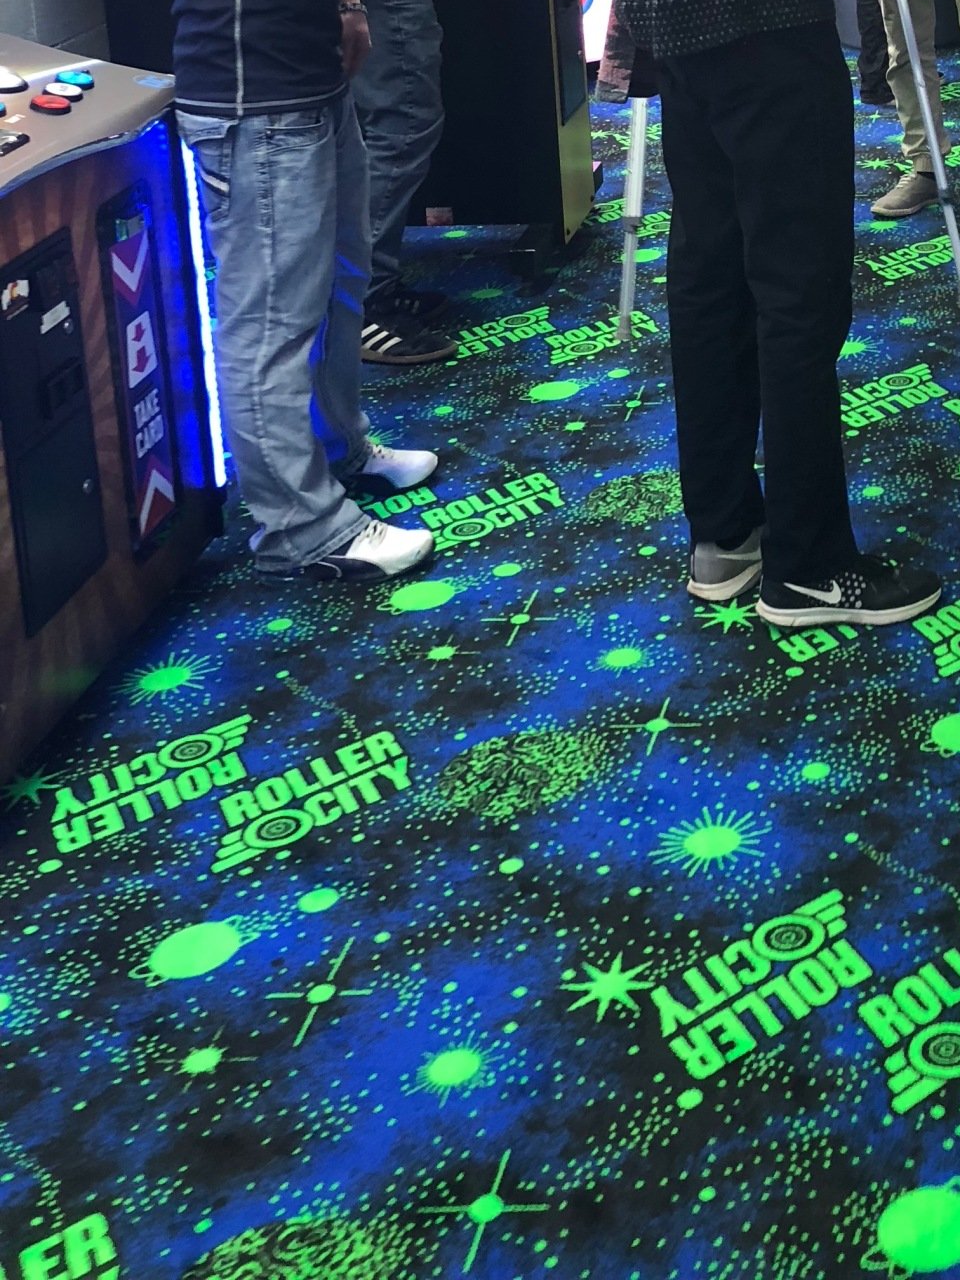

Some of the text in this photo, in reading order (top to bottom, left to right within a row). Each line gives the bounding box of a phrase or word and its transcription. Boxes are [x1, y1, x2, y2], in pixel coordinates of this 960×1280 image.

[864, 247, 919, 272] CITY
[458, 320, 506, 344] CIT
[134, 388, 160, 430] TAKE
[135, 414, 165, 459] CARD
[420, 472, 556, 530] ROLLER
[484, 486, 566, 529] CITY
[50, 752, 167, 824] CITY
[52, 751, 248, 854] ROLLER
[218, 730, 404, 828] ROLLER
[303, 755, 412, 827] CITY
[650, 939, 772, 1039] CITY
[668, 938, 874, 1080] ROLLER
